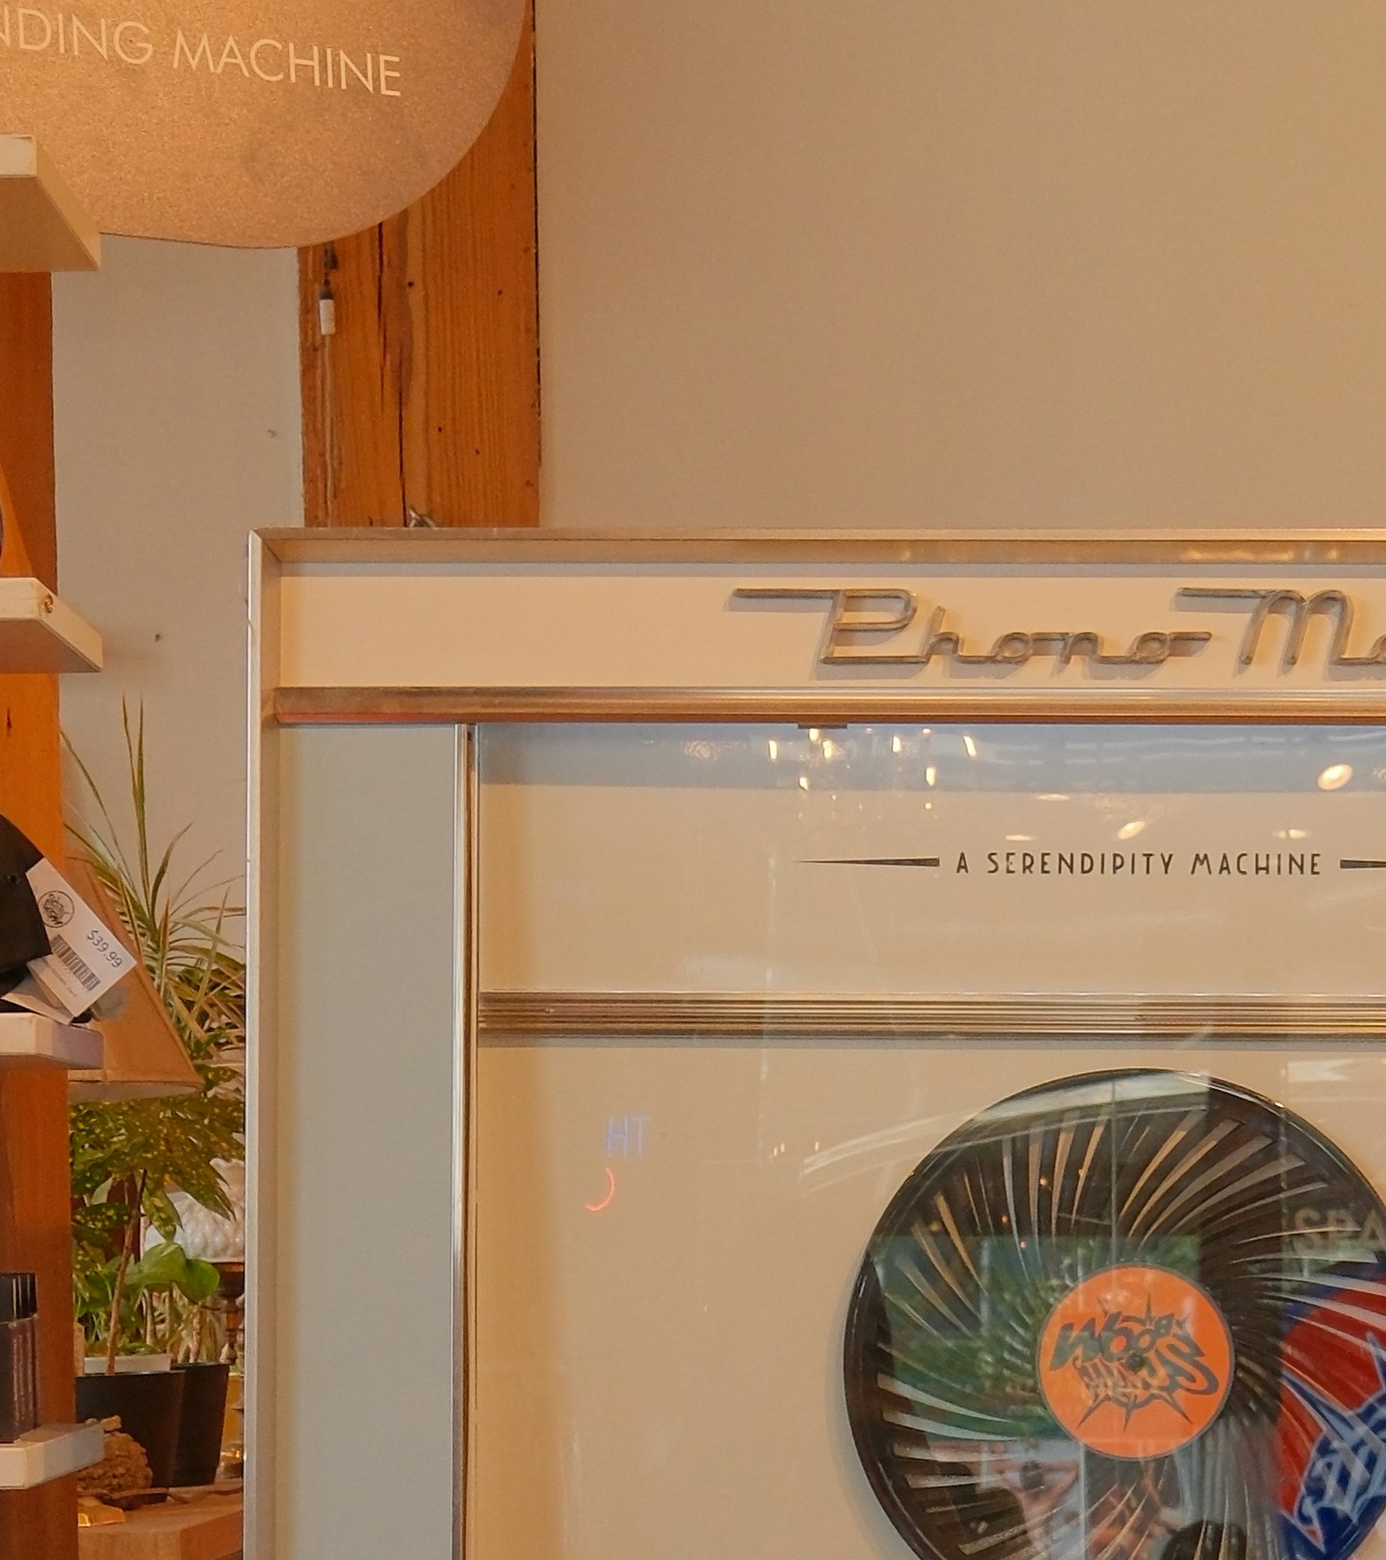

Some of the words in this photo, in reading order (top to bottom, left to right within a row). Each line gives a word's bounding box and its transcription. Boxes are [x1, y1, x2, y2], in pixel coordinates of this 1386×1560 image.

[173, 29, 401, 96] MACHINE
[956, 852, 969, 874] A
[987, 852, 1174, 875] SERENDIPITY
[1190, 853, 1321, 876] MACHINE
[88, 930, 123, 968] $39.99
